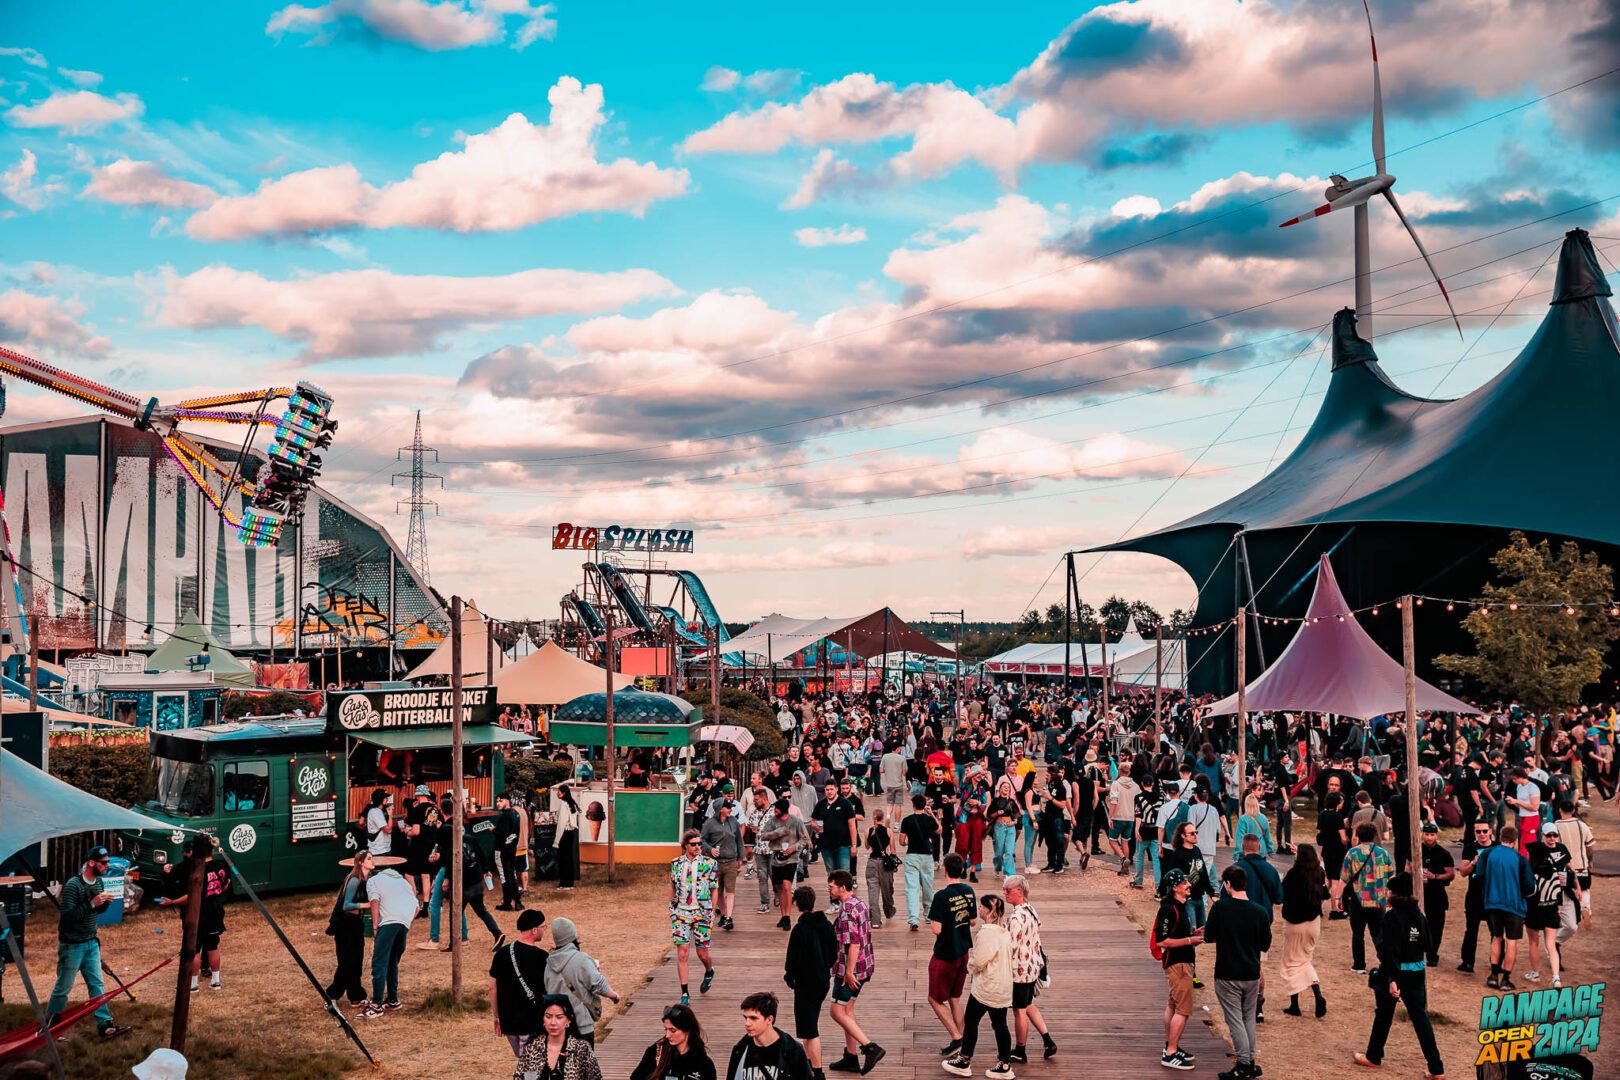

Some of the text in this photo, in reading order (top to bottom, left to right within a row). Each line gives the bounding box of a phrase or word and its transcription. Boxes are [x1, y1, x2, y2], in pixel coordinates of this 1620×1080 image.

[554, 522, 694, 553] BIG SPLASH
[301, 582, 380, 615] OPEN
[384, 692, 439, 709] BROODJE
[344, 709, 366, 726] Kas
[383, 708, 472, 727] BITTERBALN
[301, 778, 326, 797] Kas
[234, 836, 252, 850] Kas
